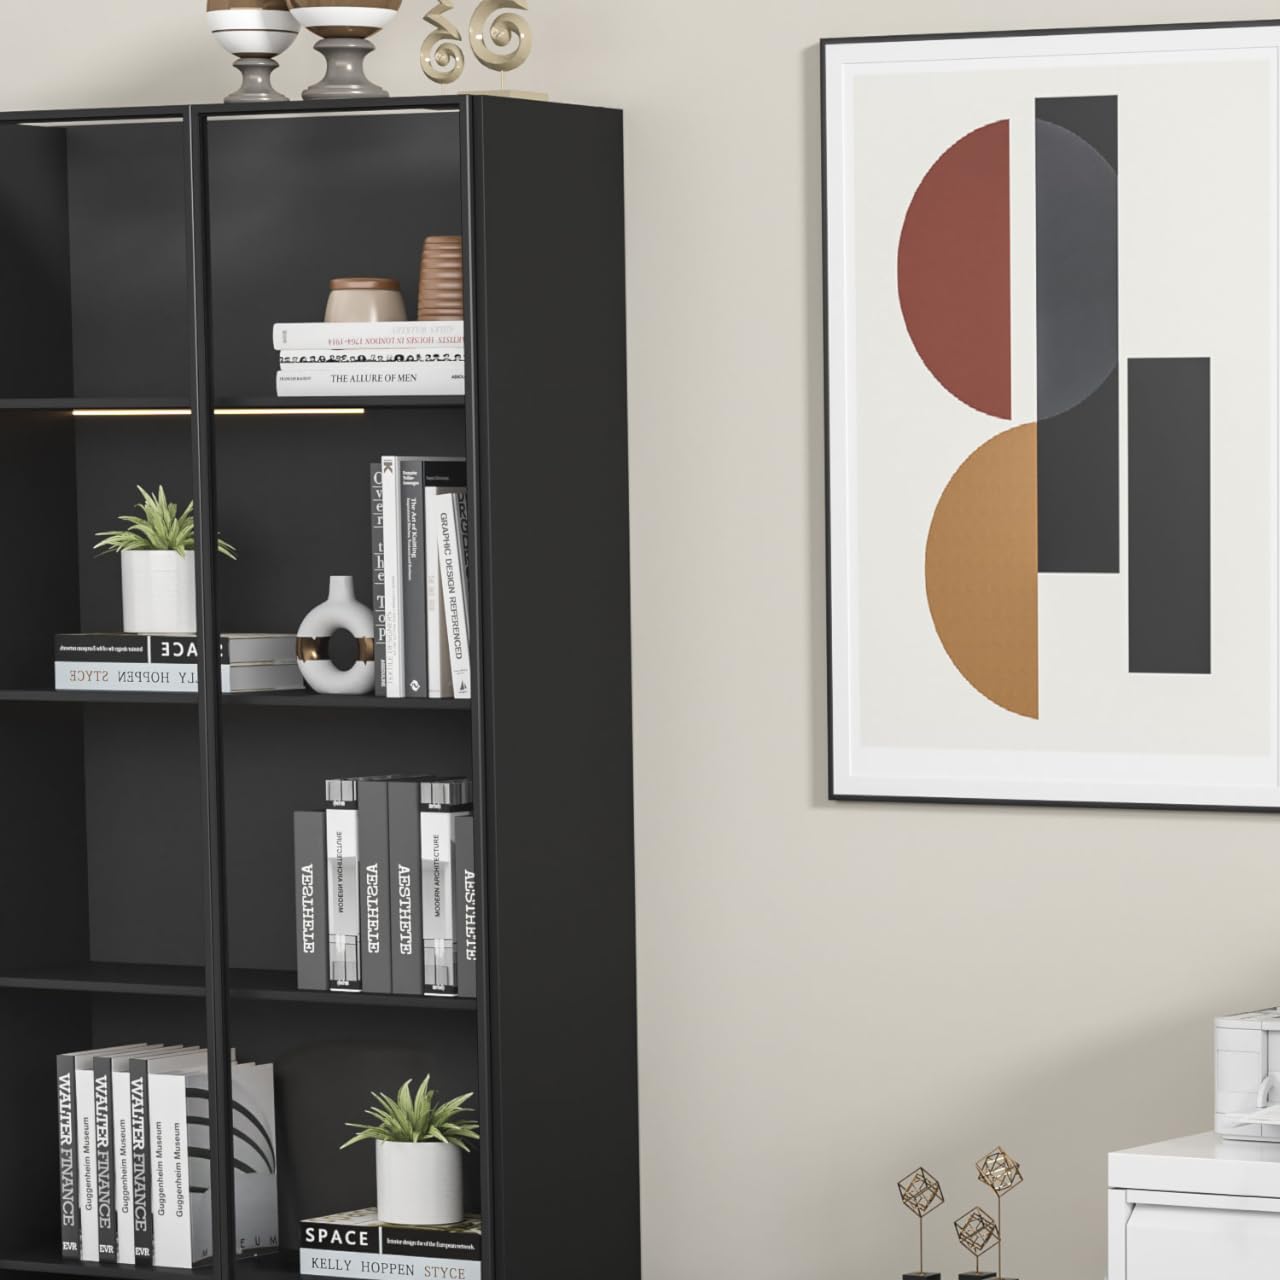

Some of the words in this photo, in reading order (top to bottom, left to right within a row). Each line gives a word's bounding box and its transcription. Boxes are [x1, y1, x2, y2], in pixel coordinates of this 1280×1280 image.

[365, 337, 394, 345] LONDON
[331, 375, 348, 383] THE
[350, 374, 384, 383] ALLURE
[385, 374, 397, 382] OF
[398, 374, 417, 382] MEN
[440, 512, 451, 556] GRAPHIC
[445, 558, 456, 594] DESIGN
[449, 596, 462, 660] REFERENCED
[399, 864, 412, 955] AESTHETE
[465, 869, 477, 961] AESTHETE
[58, 1073, 72, 1146] WALTER
[95, 1075, 109, 1148] WALTER
[131, 1077, 145, 1150] WALTER
[61, 1148, 75, 1227] FINANCE
[84, 1157, 93, 1211] Guggenheim
[97, 1150, 111, 1229] FINANCE
[121, 1159, 130, 1213] Guggenheim
[133, 1152, 147, 1232] FINANCE
[157, 1161, 167, 1216] Guggenheim
[175, 1162, 185, 1218] Guggenheim
[305, 1227, 369, 1246] SPACE
[311, 1257, 351, 1271] KELLY
[361, 1260, 415, 1276] HOPPEN
[424, 1266, 465, 1280] STYCE
